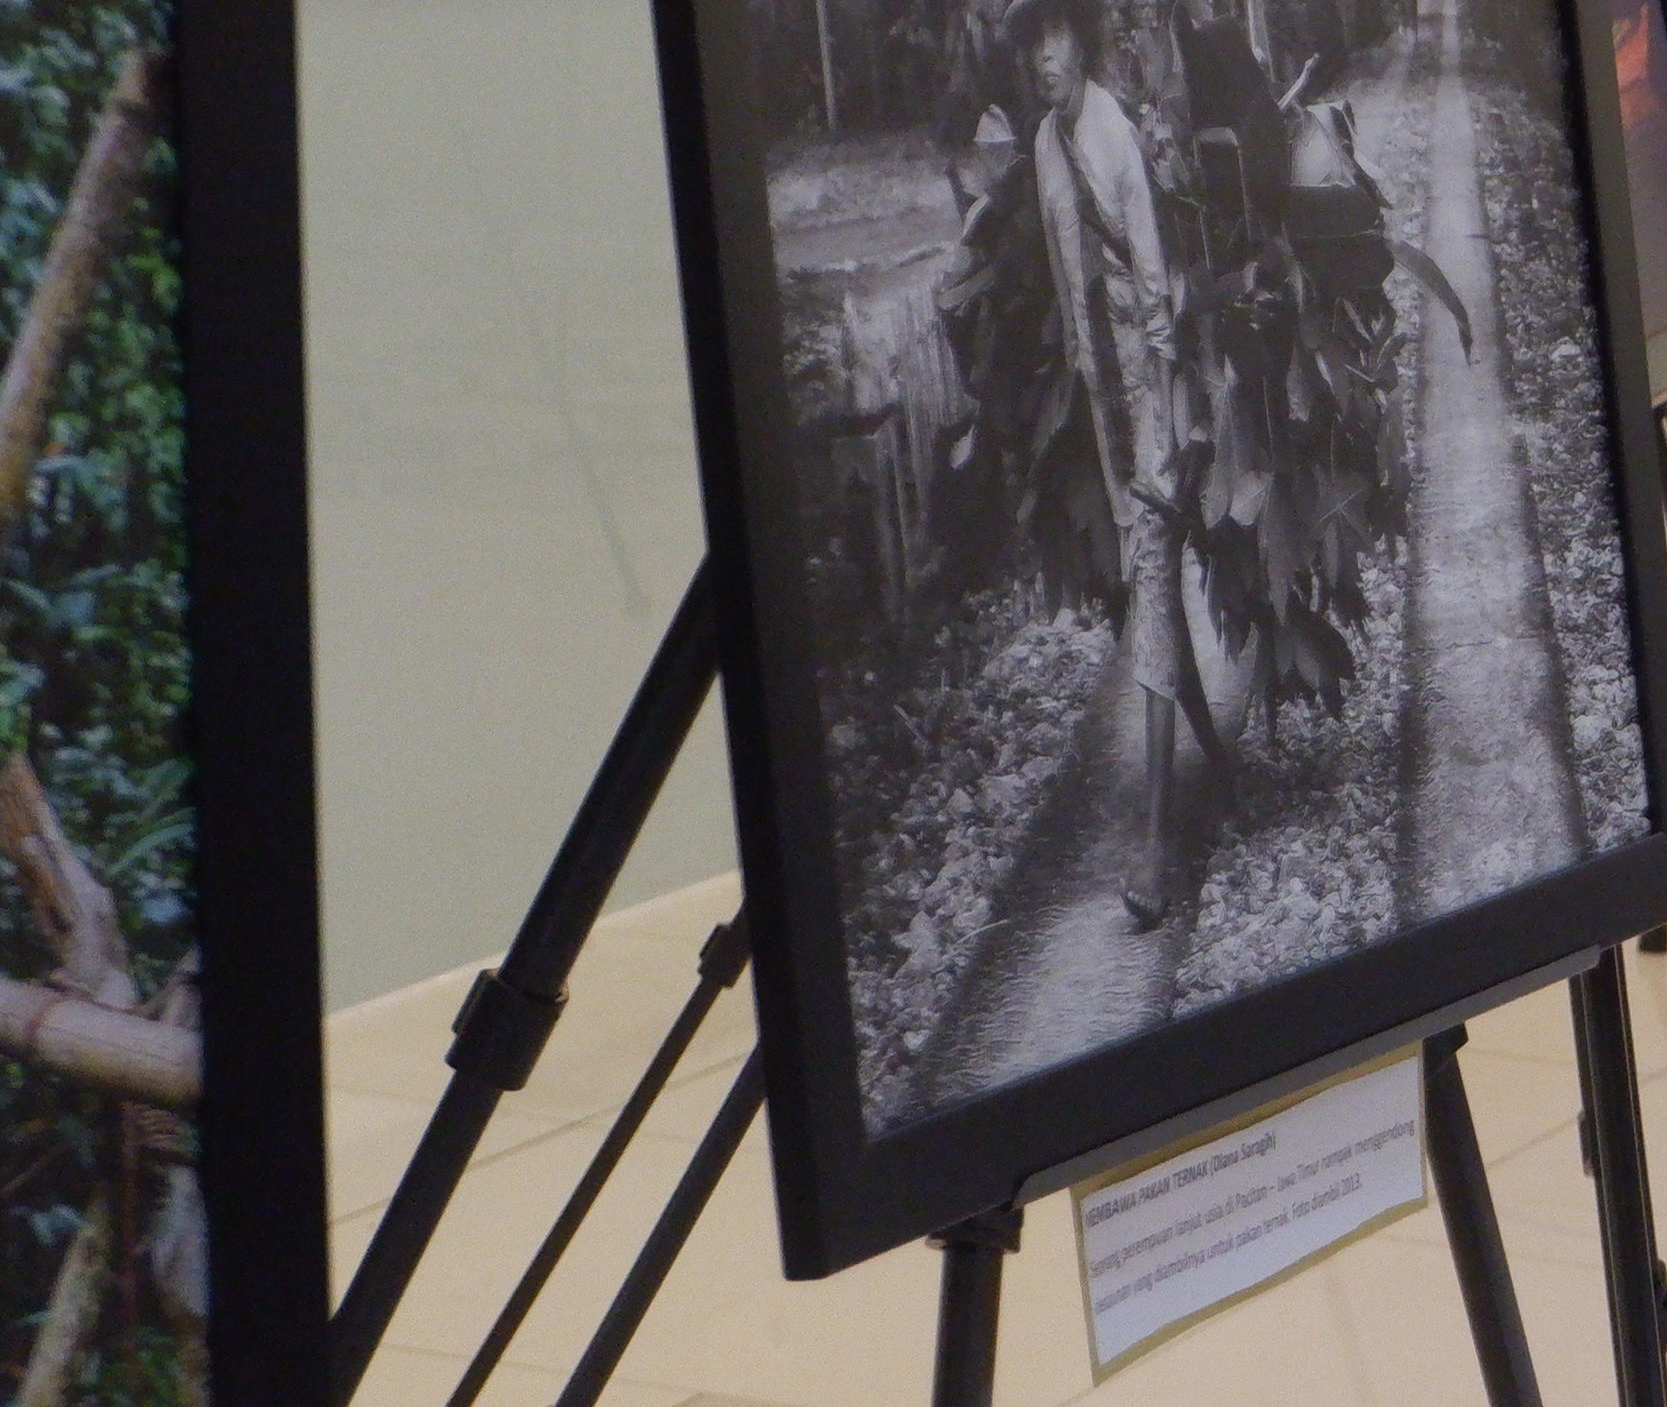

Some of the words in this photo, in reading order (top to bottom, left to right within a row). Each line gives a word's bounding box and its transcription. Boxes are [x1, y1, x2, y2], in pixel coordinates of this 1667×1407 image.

[1121, 1227, 1174, 1262] perempuan
[1205, 1204, 1224, 1224] usia
[1236, 1184, 1267, 1209] Pacitan
[1355, 1119, 1416, 1154] menggendong
[1138, 1177, 1170, 1205] PAKAN
[1172, 1161, 1209, 1188] TERNAK
[1210, 1150, 1239, 1177] (Diana
[1206, 1237, 1235, 1260] untuk
